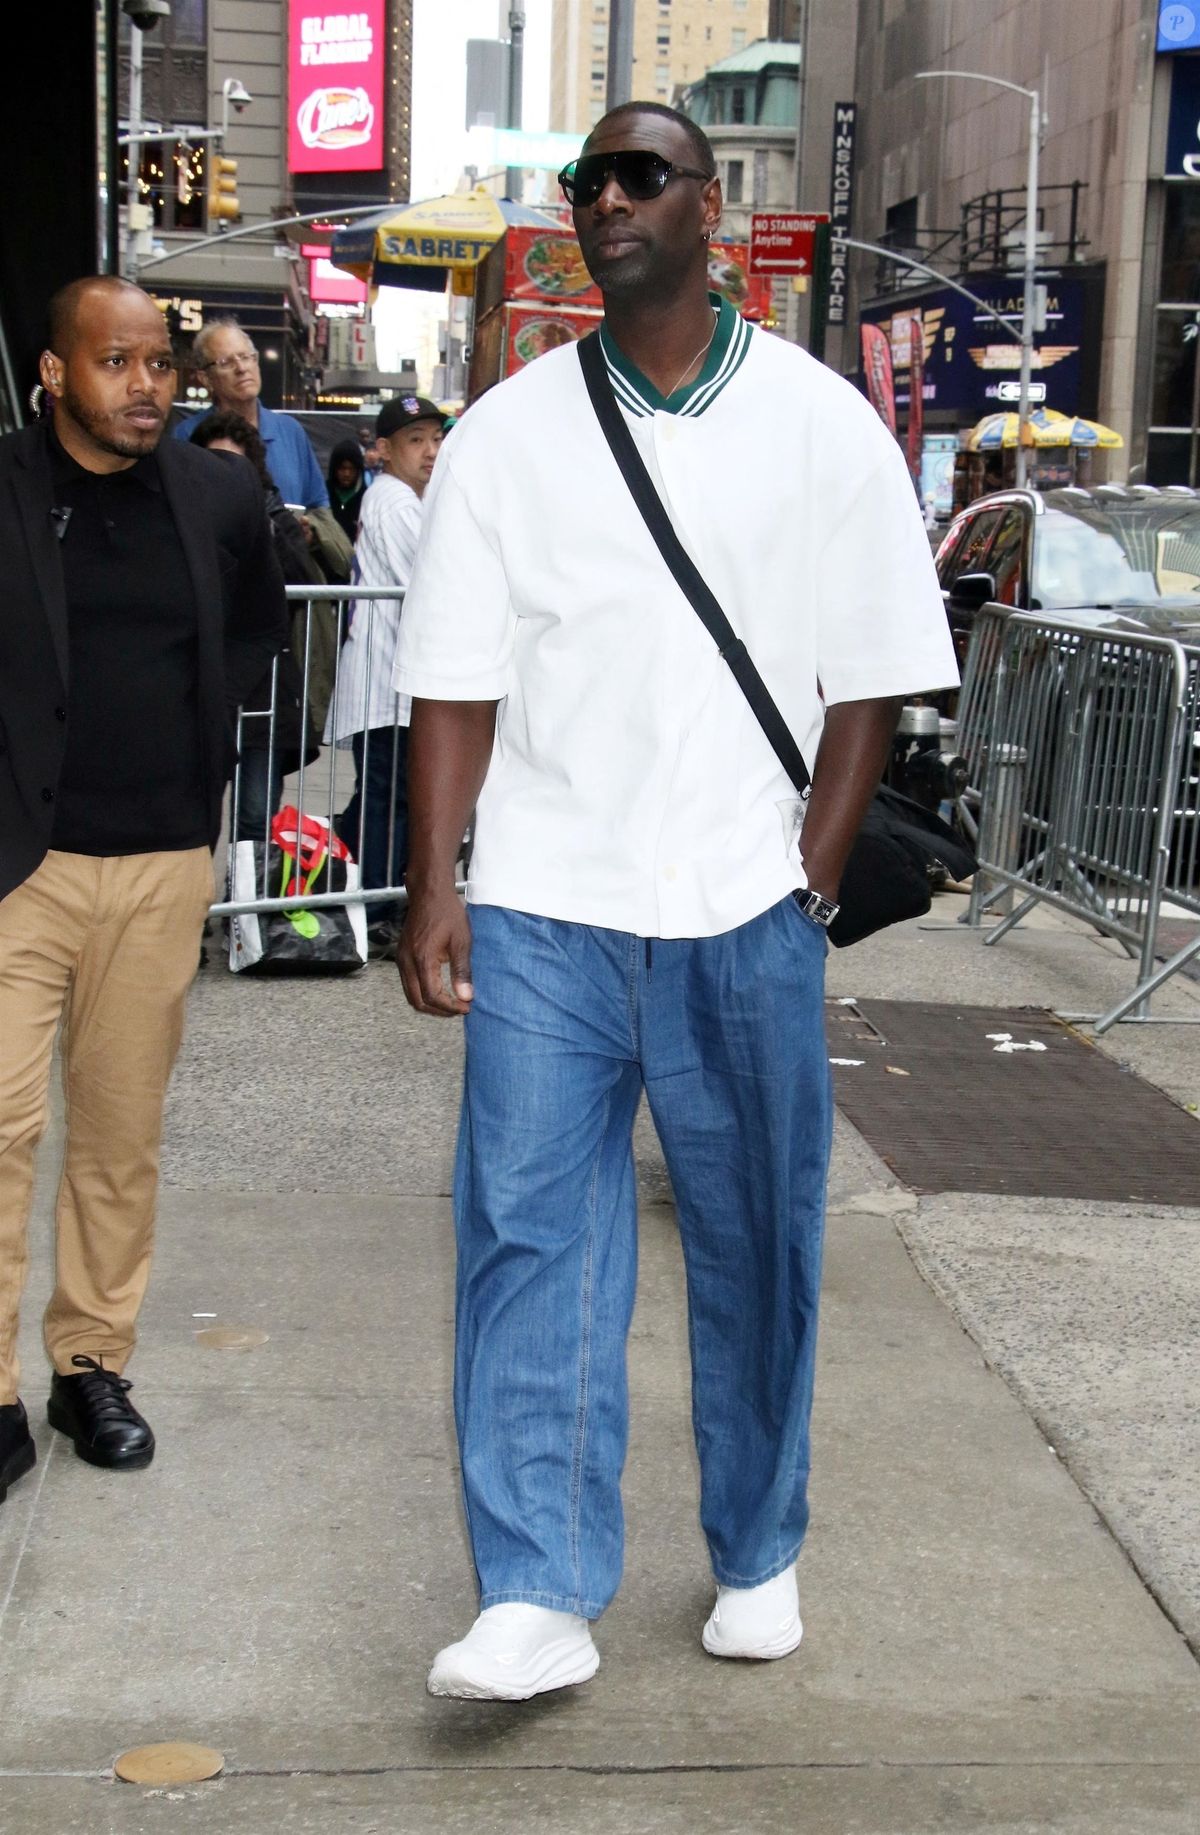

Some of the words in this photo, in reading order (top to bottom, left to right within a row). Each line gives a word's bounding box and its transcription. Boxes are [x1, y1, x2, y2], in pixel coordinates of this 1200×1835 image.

[301, 13, 372, 43] GLOBAL
[300, 41, 372, 65] FLAGSHIP
[834, 109, 853, 217] MINSKOFF
[754, 219, 768, 231] NO
[770, 219, 816, 232] STANDING
[755, 234, 793, 247] Anytime
[829, 227, 847, 320] THEATRE
